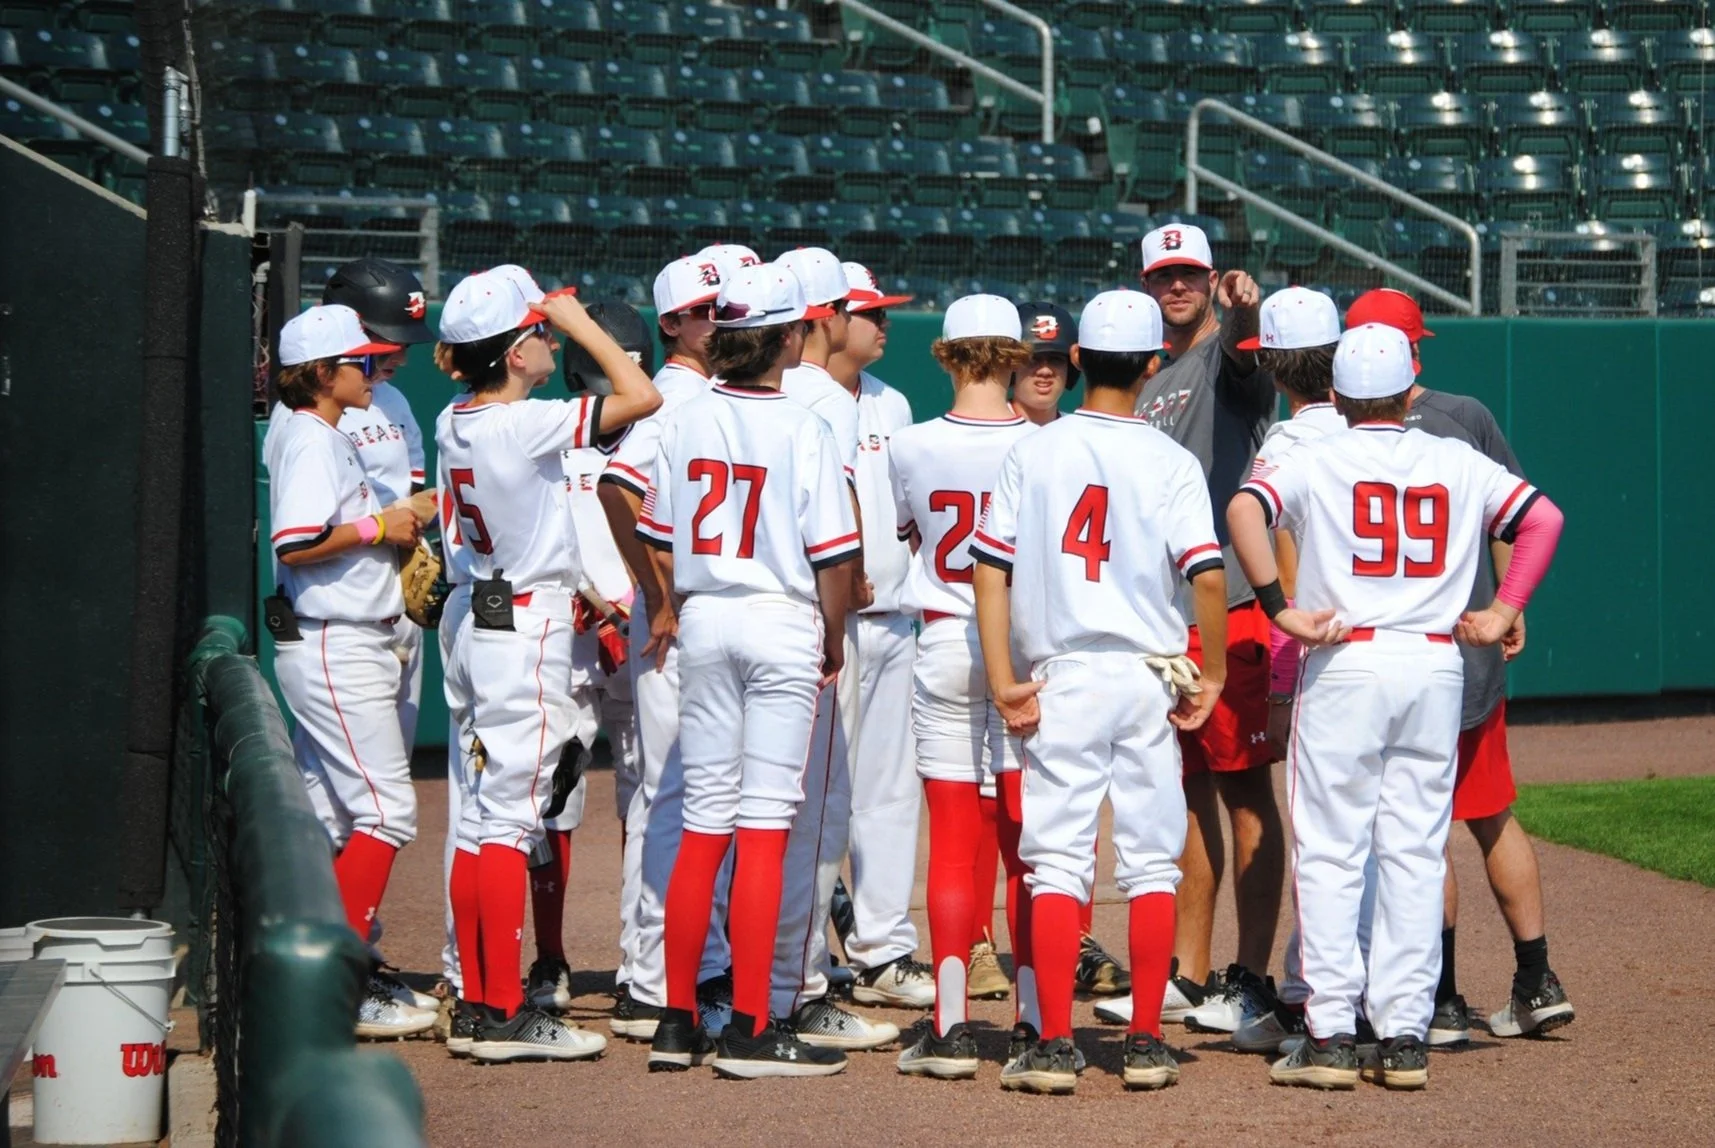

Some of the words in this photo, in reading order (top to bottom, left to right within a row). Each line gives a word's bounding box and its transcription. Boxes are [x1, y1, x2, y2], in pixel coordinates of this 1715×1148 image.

[687, 458, 768, 559] 27
[1061, 483, 1112, 583] 4
[1352, 480, 1450, 578] 99
